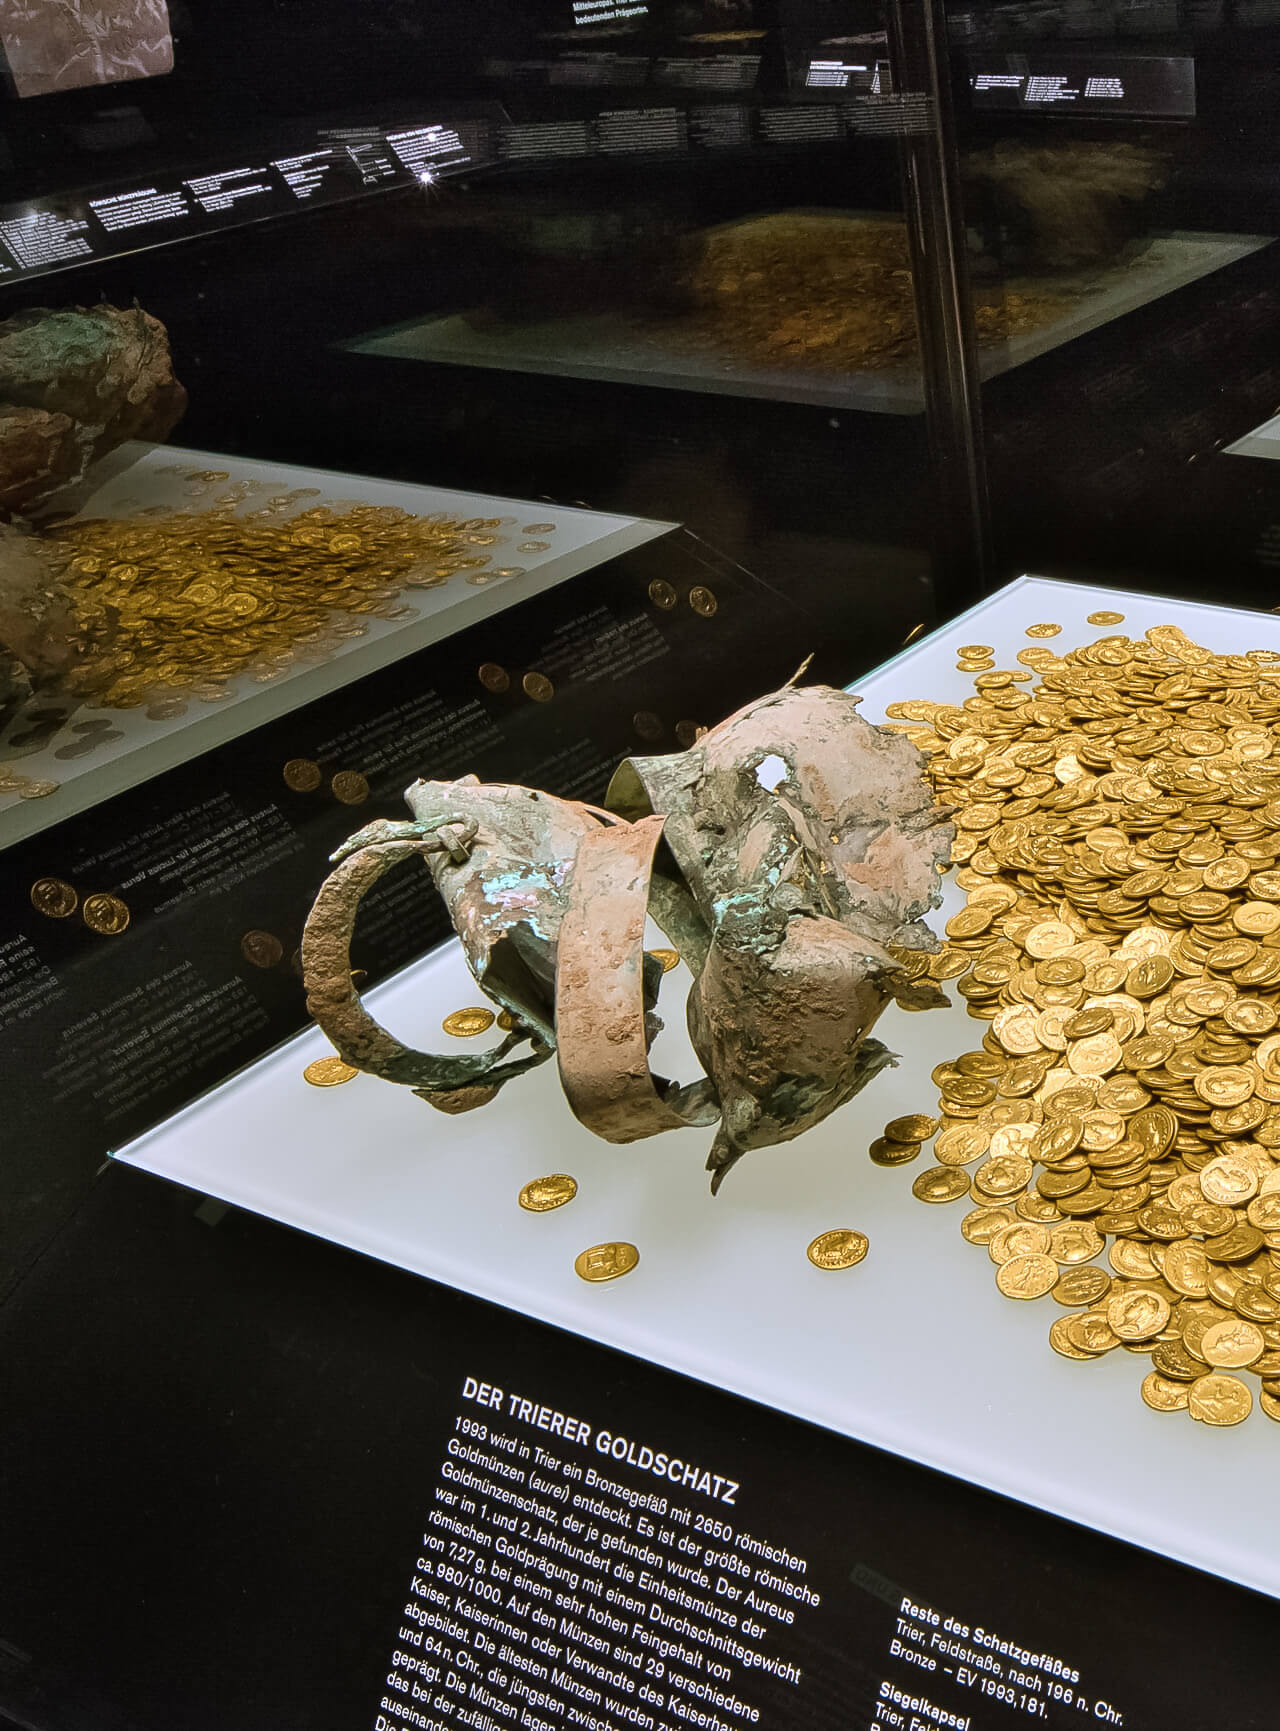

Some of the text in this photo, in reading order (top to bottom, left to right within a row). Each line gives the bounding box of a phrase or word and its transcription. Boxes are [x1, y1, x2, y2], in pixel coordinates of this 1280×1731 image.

[455, 1416, 807, 1574] 1993 wird in Trier ein Bronzegefäß mit 2650 römischen
[462, 1376, 740, 1505] DER TRIERER GOLDSCHATZ
[435, 1487, 767, 1640] war im 1. und 2. Jahrhundert die Einheitsmünze der
[441, 1461, 795, 1625] Goldmünzenschatz, der je gefunden wurde. Der Aureus
[447, 1438, 820, 1607] Goldmünzen (aurei) entdeckt. Es ist der größte römische
[410, 1576, 664, 1707] Kaiser, Kaiserinnen oder Verwandte des
[416, 1557, 760, 1722] ca. 980/1000. Auf den Münzen sind 29 verschiedene
[423, 1533, 731, 1682] von 7,27 g, bei einem sehr hohen Feingehalt von
[428, 1510, 801, 1685] römischen Goldprägung mit einem Durchschnittsgewicht
[900, 1597, 1080, 1683] Reste des Schatzgefäßes
[386, 1671, 456, 1714] das bei der
[392, 1650, 441, 1683] geprägt.
[445, 1670, 467, 1694] Die
[468, 1682, 518, 1720] Münzen
[398, 1626, 565, 1716] und 64 n. Chr., die jüngsten
[404, 1602, 654, 1730] abgebildet. Die ältesten Münzen wurden
[889, 1638, 937, 1671] Bronze
[956, 1666, 978, 1687] EV
[981, 1678, 1048, 1719] 1993,181.
[896, 1617, 1123, 1727] Trier, Feldstraße, nach 196 n. Chr.
